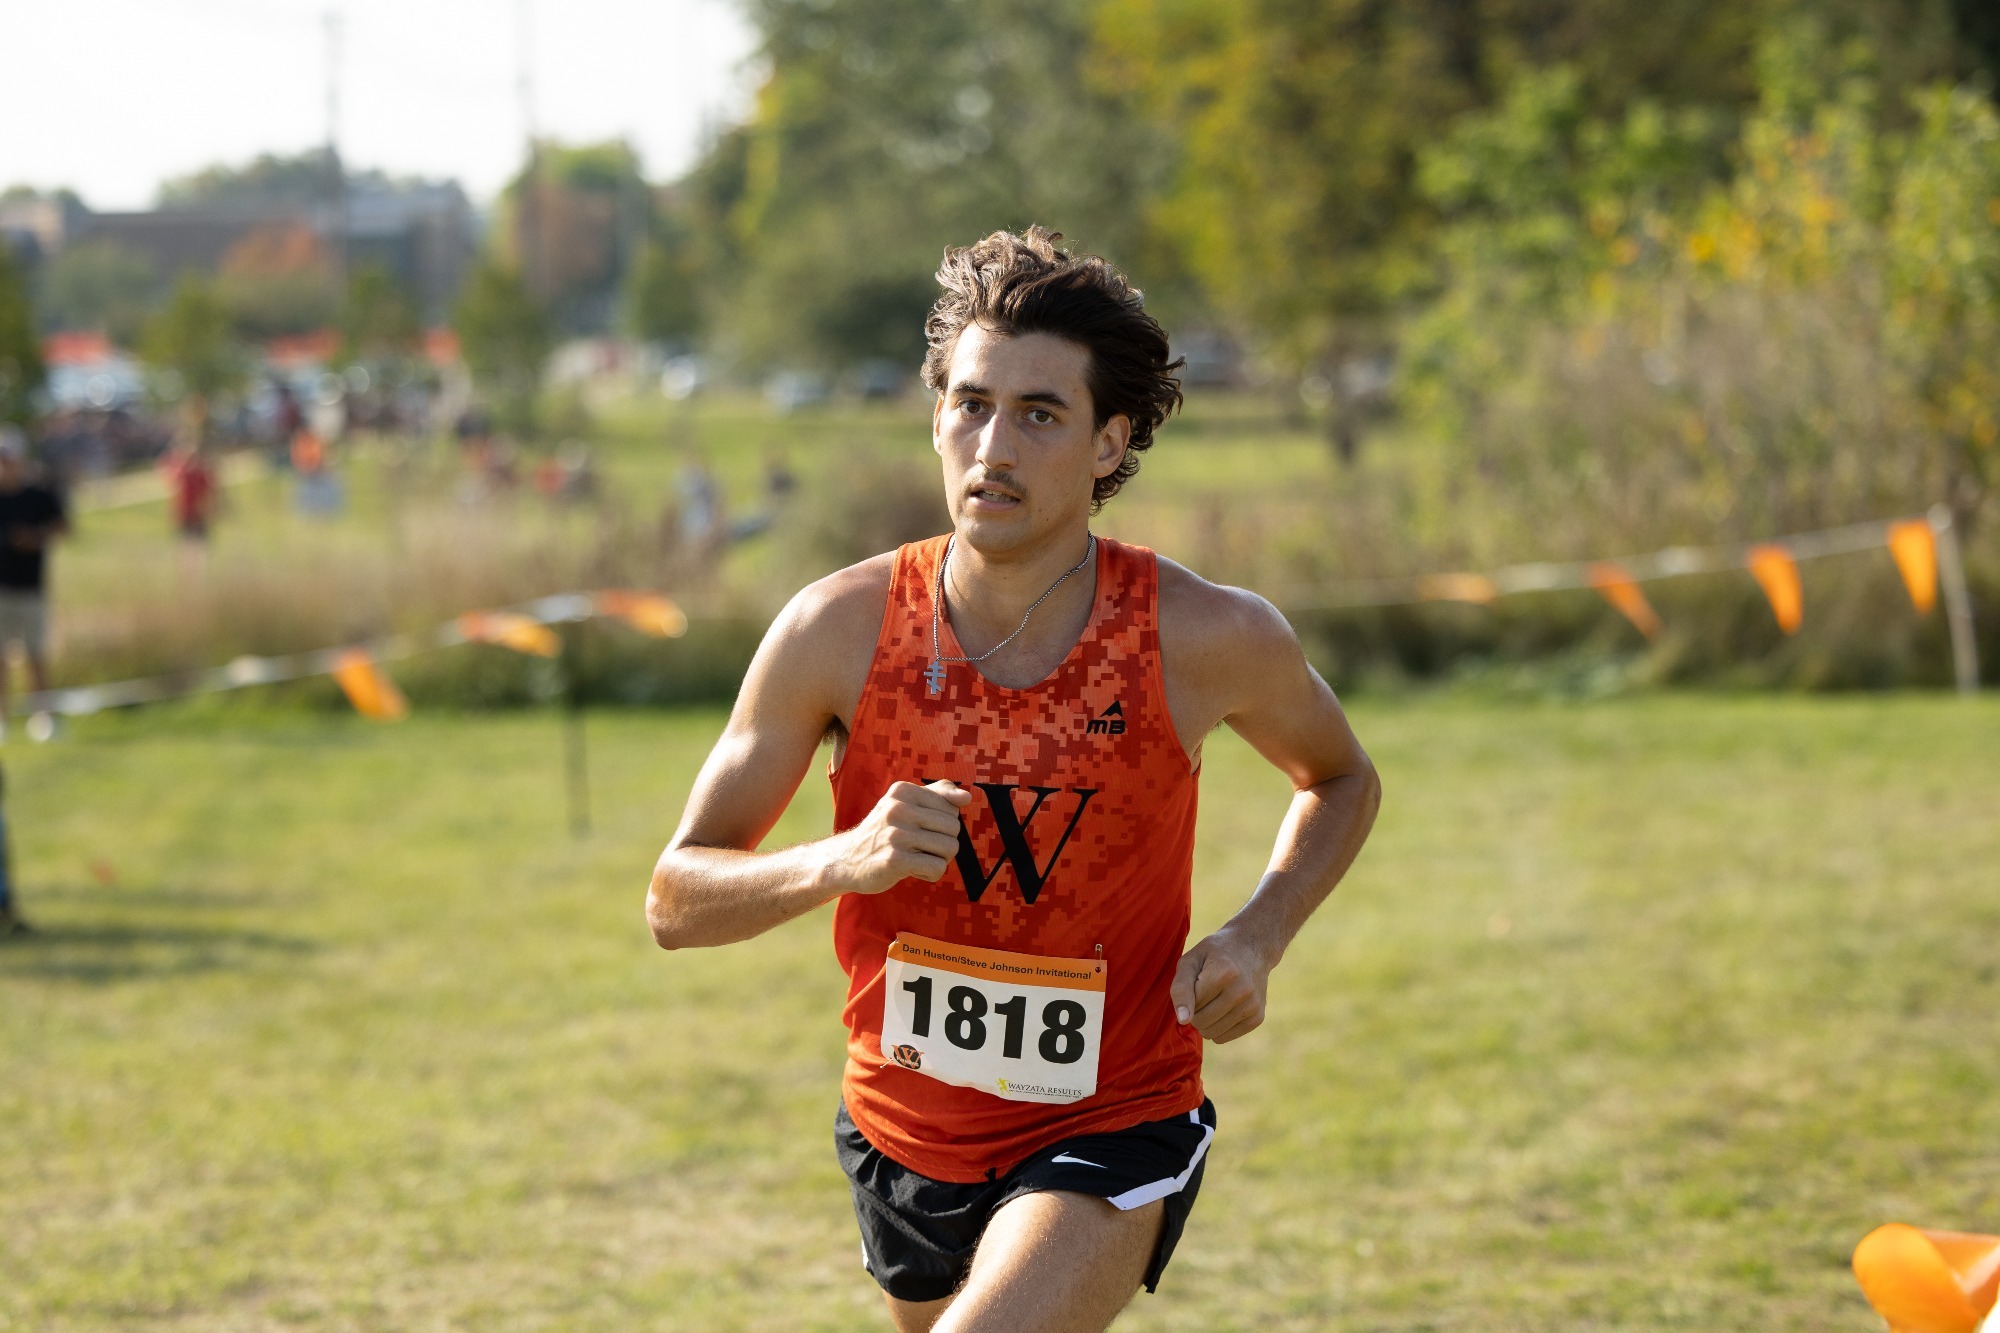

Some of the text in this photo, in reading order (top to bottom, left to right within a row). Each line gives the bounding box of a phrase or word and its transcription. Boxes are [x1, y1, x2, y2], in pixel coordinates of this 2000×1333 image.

[921, 778, 1099, 905] W
[902, 943, 1092, 980] Dan Huston/Steve Johnson Invitational
[902, 975, 1087, 1064] 1818
[1008, 1082, 1045, 1093] WAYZATA
[1047, 1086, 1082, 1096] RESULTS
